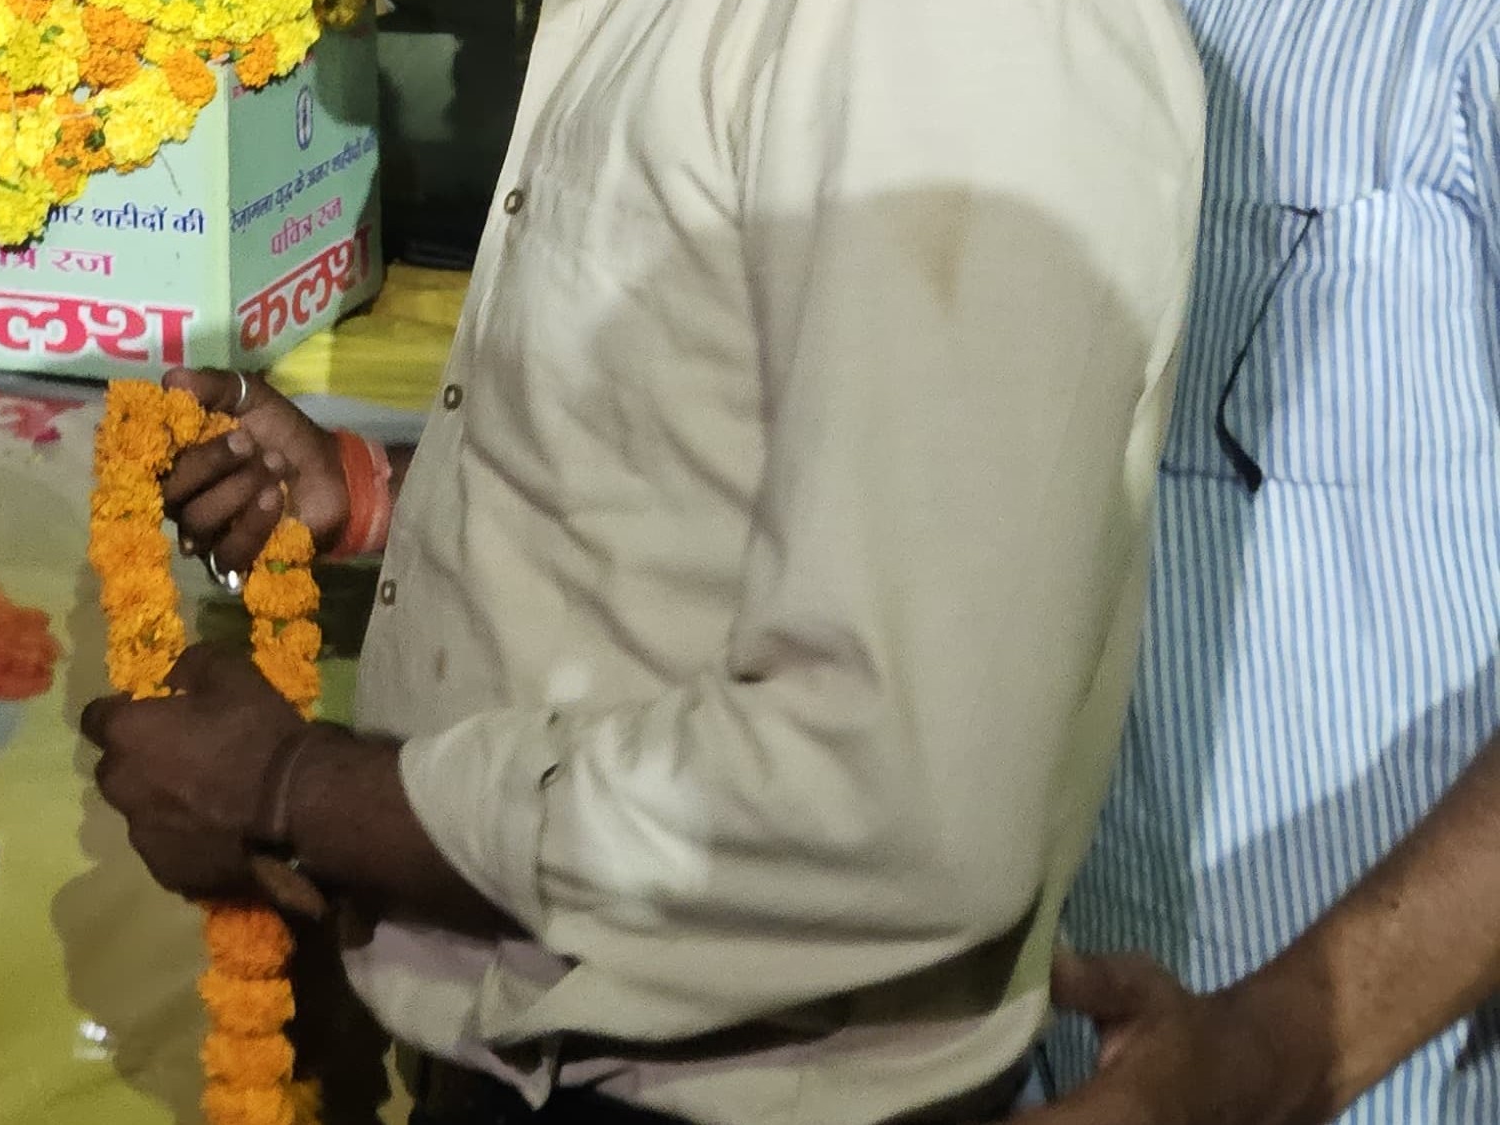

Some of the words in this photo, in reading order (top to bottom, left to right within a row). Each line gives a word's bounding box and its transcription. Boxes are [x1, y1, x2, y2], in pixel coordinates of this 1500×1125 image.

[47, 204, 85, 226] मर
[91, 201, 168, 234] शहीदों
[172, 208, 205, 235] की
[270, 216, 313, 255] पवित्र
[316, 196, 342, 229] रज
[50, 248, 116, 277] रज
[236, 223, 374, 351] कलश
